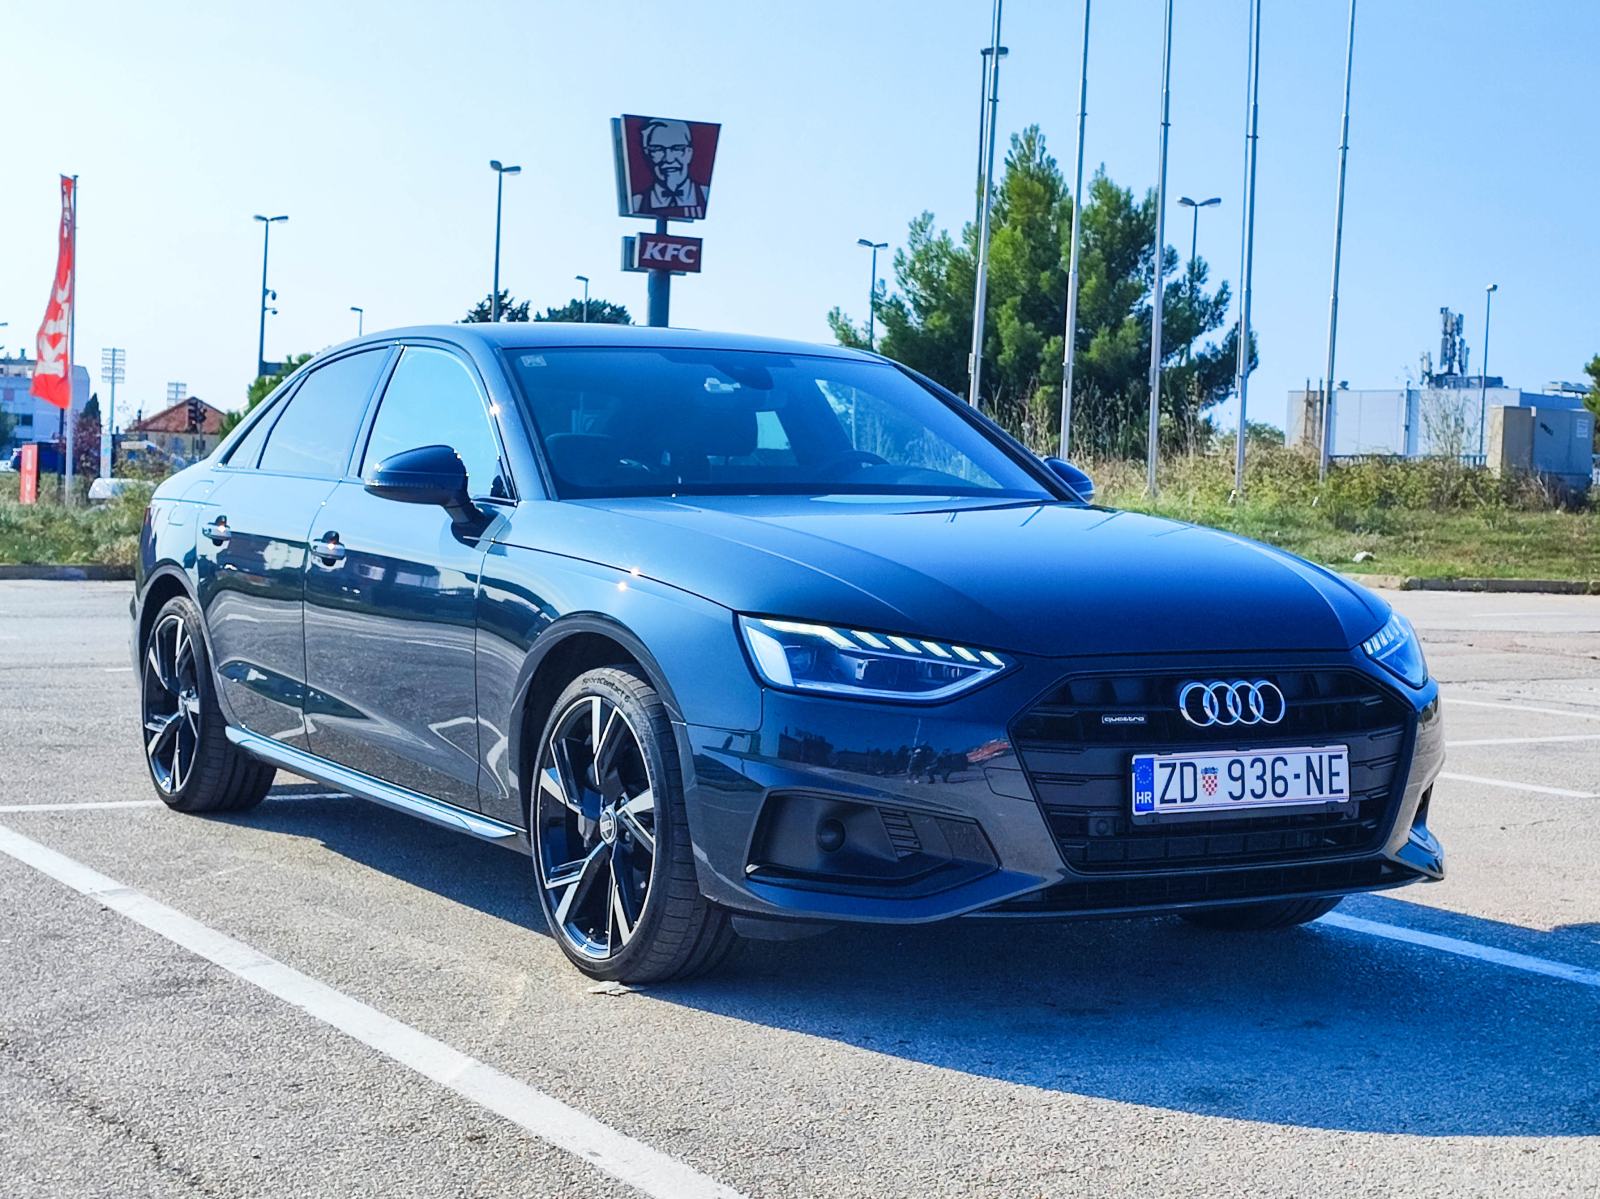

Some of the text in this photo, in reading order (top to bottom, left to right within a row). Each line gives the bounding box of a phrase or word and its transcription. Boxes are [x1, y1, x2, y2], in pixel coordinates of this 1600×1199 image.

[642, 241, 698, 263] KFC
[1158, 753, 1345, 805] ZD 936-NE
[1136, 791, 1152, 804] HR
